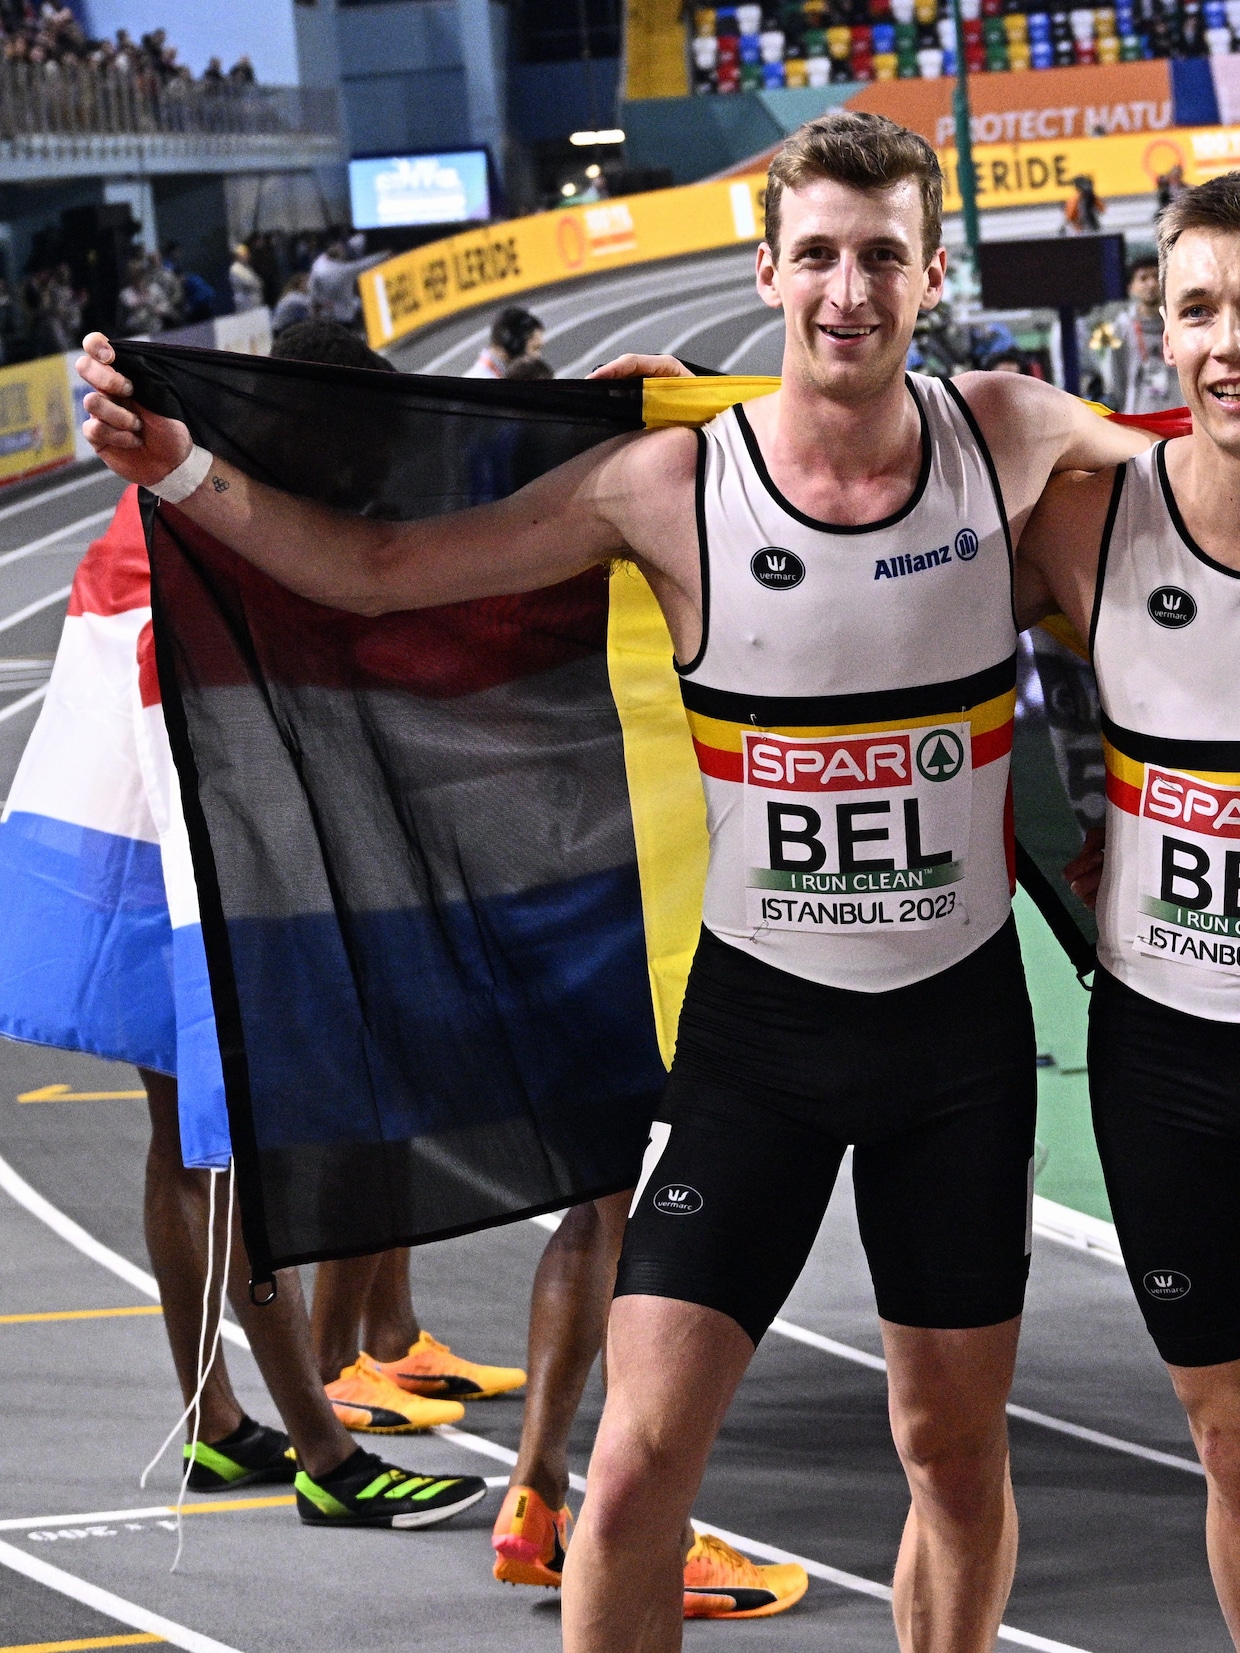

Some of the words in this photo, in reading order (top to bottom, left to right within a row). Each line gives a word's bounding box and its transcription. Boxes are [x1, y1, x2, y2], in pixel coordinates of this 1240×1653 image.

[874, 544, 952, 580] Allianz
[759, 571, 797, 582] vermarc
[1154, 609, 1188, 621] vermarc
[751, 742, 907, 785] SPAR
[766, 797, 953, 875] BEL
[791, 875, 797, 889] I
[802, 874, 848, 891] RUN
[761, 898, 894, 925] ISTANBUL
[899, 891, 956, 923] 2023
[1176, 909, 1183, 923] I
[1187, 913, 1233, 935] RUN
[658, 1201, 693, 1211] vermarc
